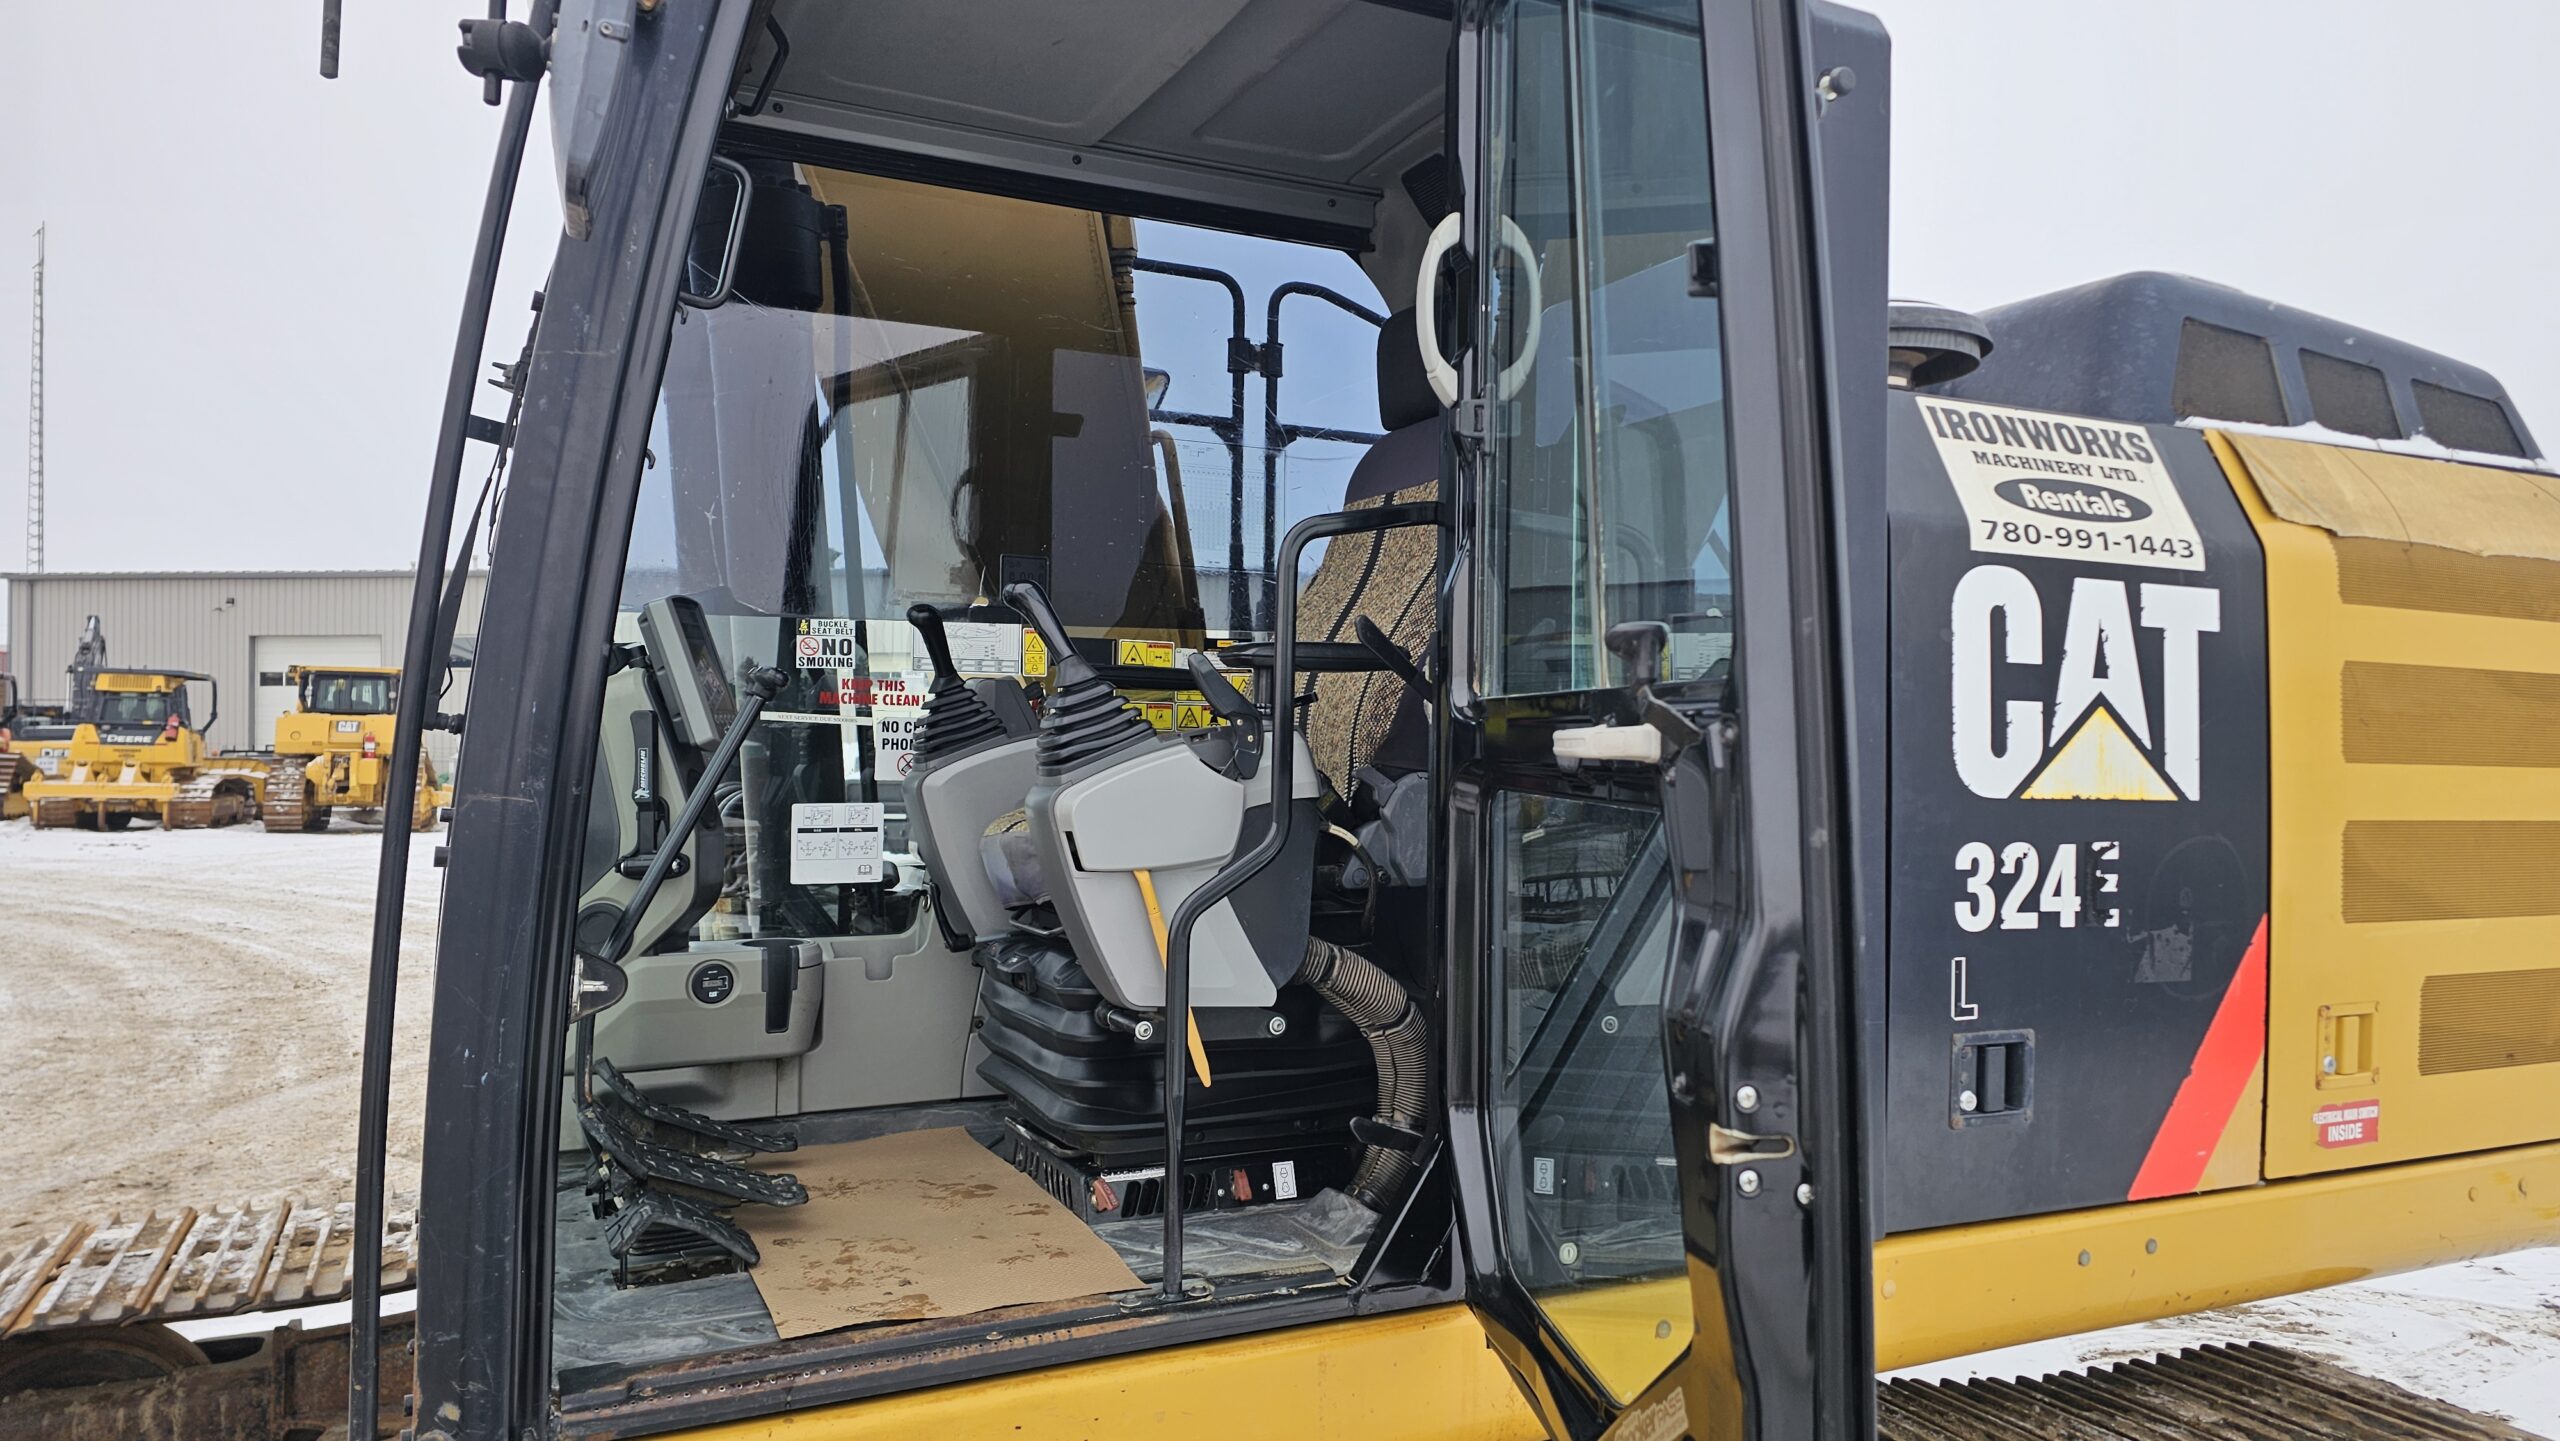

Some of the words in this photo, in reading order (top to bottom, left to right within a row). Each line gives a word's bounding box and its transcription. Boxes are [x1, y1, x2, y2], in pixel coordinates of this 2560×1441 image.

[1926, 405, 2154, 464] IRONWORKS
[1973, 450, 2093, 477] MACHINERY
[2101, 466, 2144, 483] LTD.
[2018, 482, 2133, 519] Rentals
[1981, 520, 2195, 558] 780-991-1443
[811, 627, 832, 635] SEAT
[835, 628, 854, 636] BELT
[817, 620, 848, 629] BUCKLE
[821, 638, 853, 657] NO
[798, 656, 854, 668] SMOKING
[841, 678, 874, 691] KEEP
[877, 679, 906, 692] THIS
[1951, 564, 2221, 802] CAT
[818, 691, 879, 706] MACHINE
[338, 721, 359, 732] CAT
[882, 720, 900, 733] NO
[106, 734, 153, 743] DEERE
[2327, 1122, 2364, 1143] INSIDE
